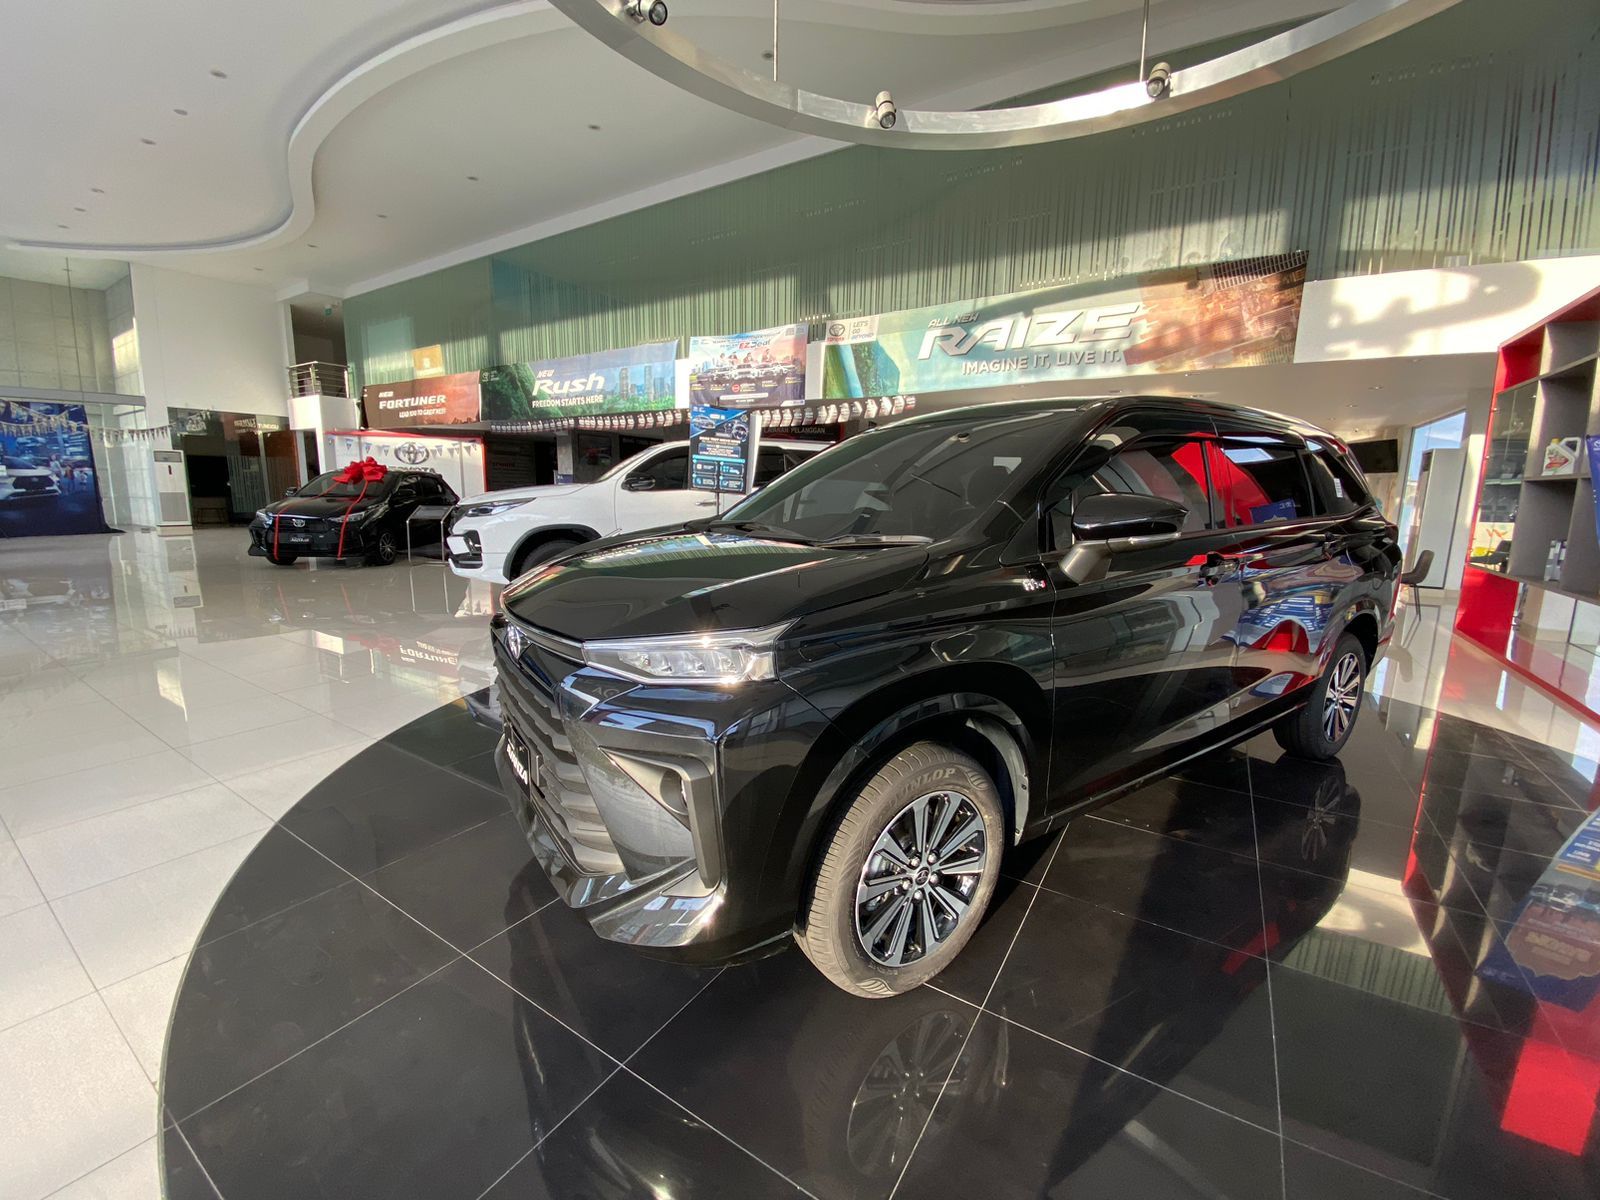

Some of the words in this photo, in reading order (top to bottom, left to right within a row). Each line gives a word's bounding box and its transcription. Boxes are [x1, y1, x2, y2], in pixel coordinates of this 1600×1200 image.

[927, 318, 951, 329] ALL
[954, 312, 981, 325] NEW
[917, 302, 1144, 361] RAIZE
[962, 357, 1029, 376] IMAGINE
[1033, 354, 1052, 369] IT,
[1056, 350, 1097, 367] LIVE
[1101, 349, 1123, 364] IT.
[536, 369, 555, 379] NEW
[532, 372, 606, 397] Rush
[379, 394, 447, 410] FORTUNER
[532, 398, 561, 408] FREEDOM
[561, 396, 585, 407] STARTS
[586, 394, 604, 404] HERE
